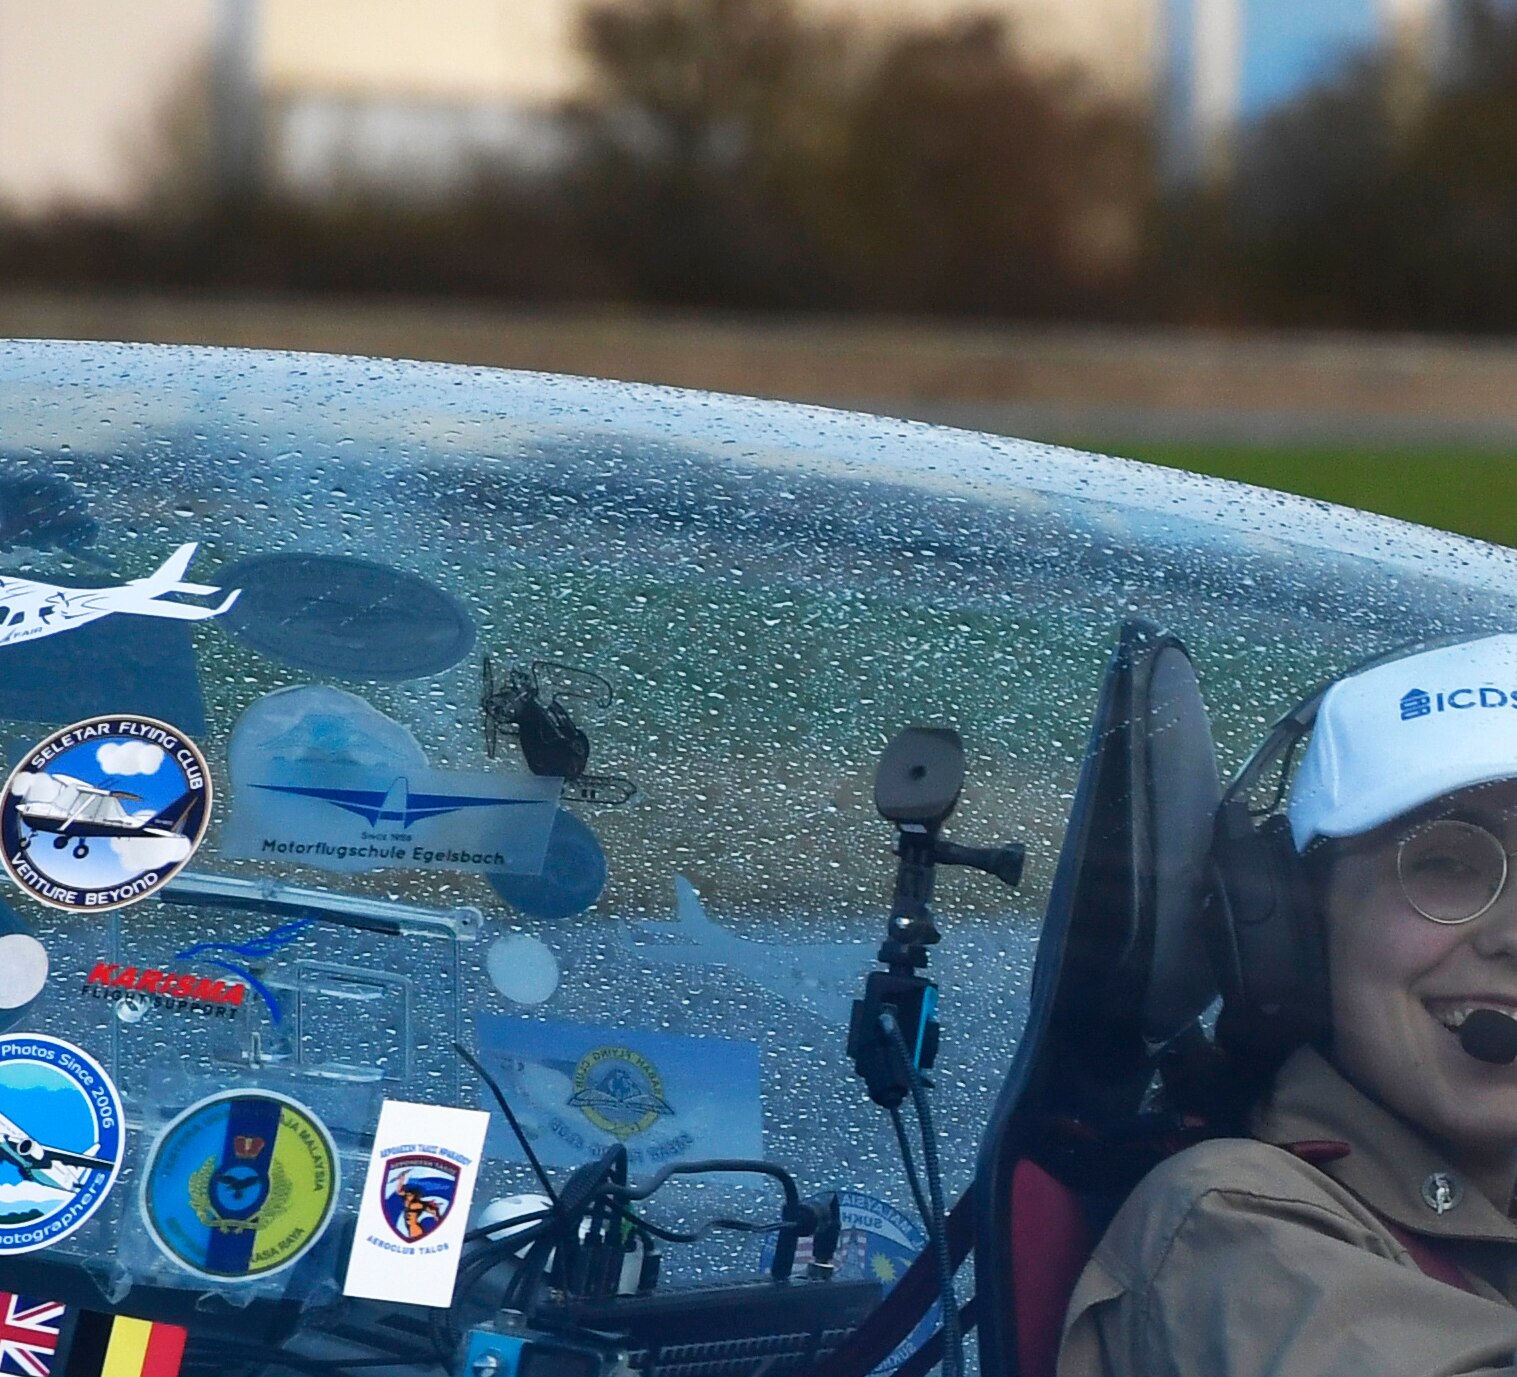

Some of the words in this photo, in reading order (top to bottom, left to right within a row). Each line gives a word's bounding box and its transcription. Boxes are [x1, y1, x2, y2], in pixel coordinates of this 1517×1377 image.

[31, 722, 111, 769] SELETAR
[119, 722, 178, 749] FLYING
[176, 749, 204, 790] CLUB
[262, 838, 406, 860] Motorflugschule
[412, 843, 505, 866] Egelsbach
[11, 852, 78, 905] VENTURE
[84, 872, 159, 906] BEYOND
[81, 985, 146, 1006] FLIGHT
[153, 1000, 238, 1020] SUPPORT
[87, 962, 247, 1007] KARISMA
[1, 1043, 55, 1060] Photos
[58, 1052, 95, 1086] Since
[91, 1086, 115, 1129] 2006
[0, 1172, 106, 1245] otographers
[366, 1234, 416, 1255] AEROCLUB
